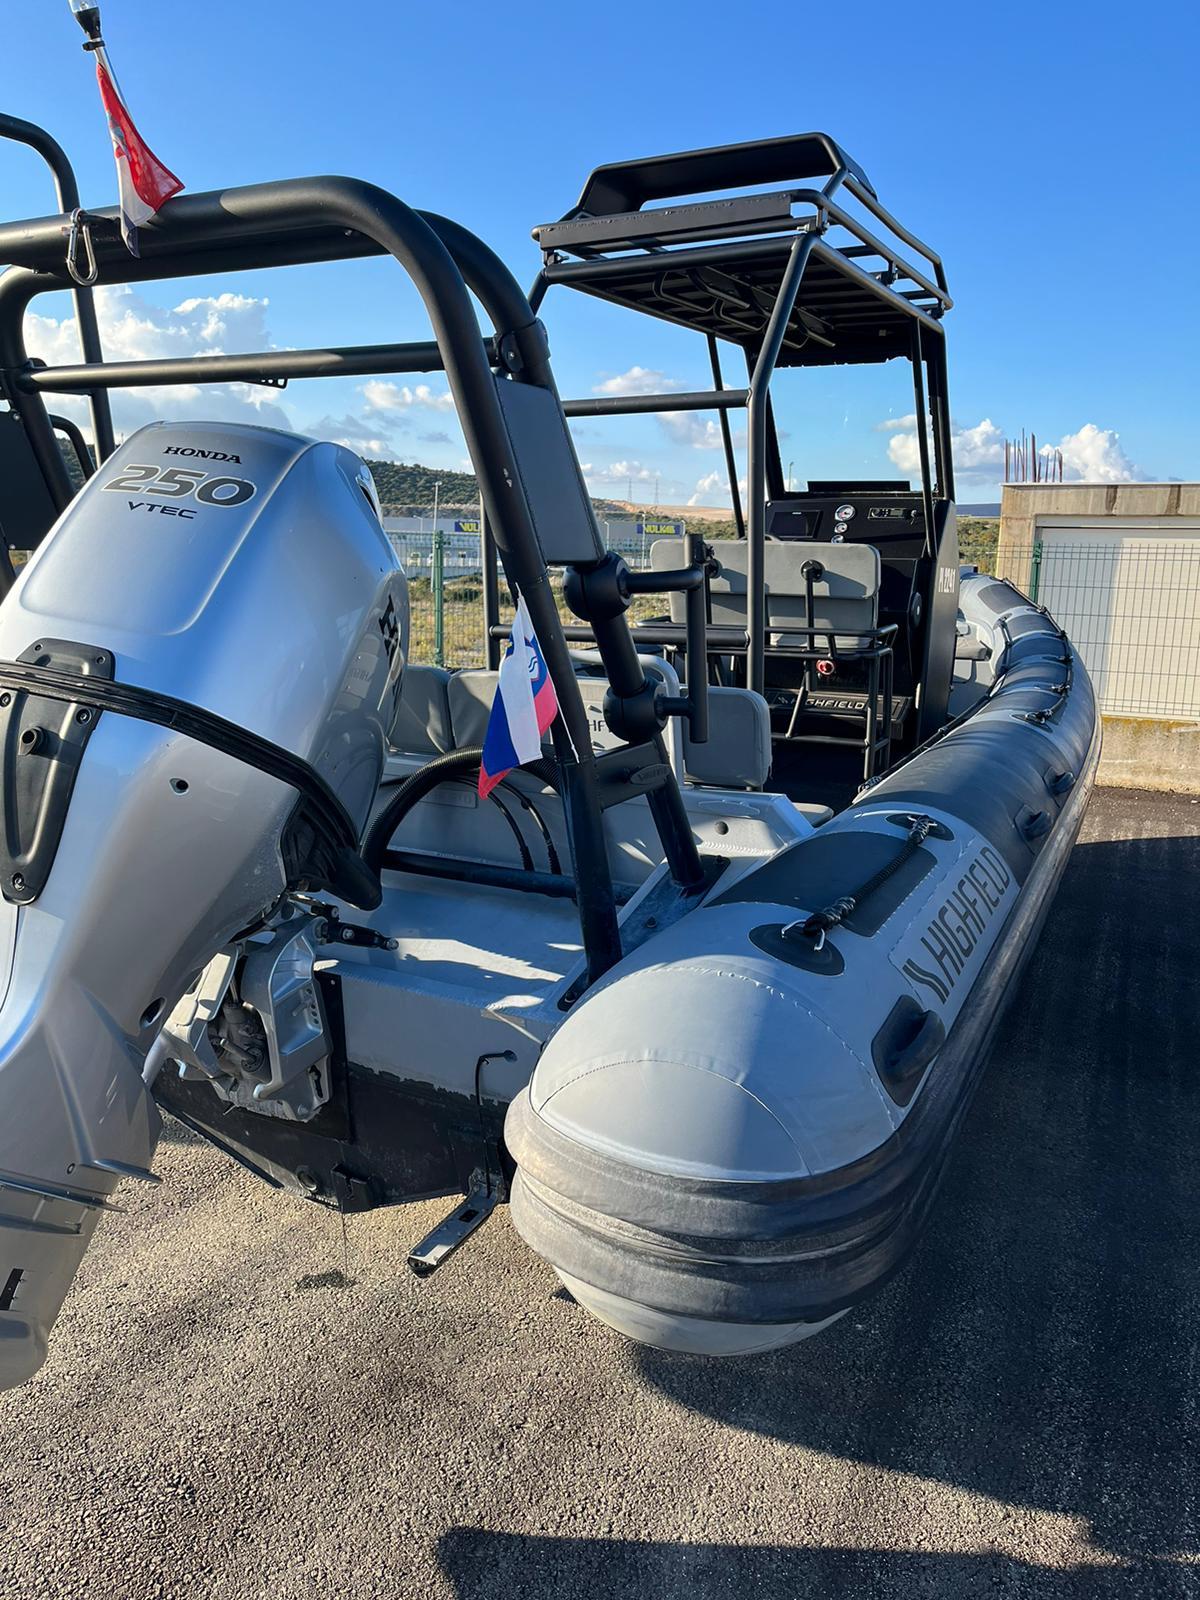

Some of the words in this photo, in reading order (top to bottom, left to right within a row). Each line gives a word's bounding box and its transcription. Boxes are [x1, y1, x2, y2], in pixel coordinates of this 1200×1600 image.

[163, 446, 242, 465] HONDA
[101, 463, 257, 508] 250
[128, 501, 198, 520] VTEC
[920, 846, 1011, 988] HIGHFIELD
